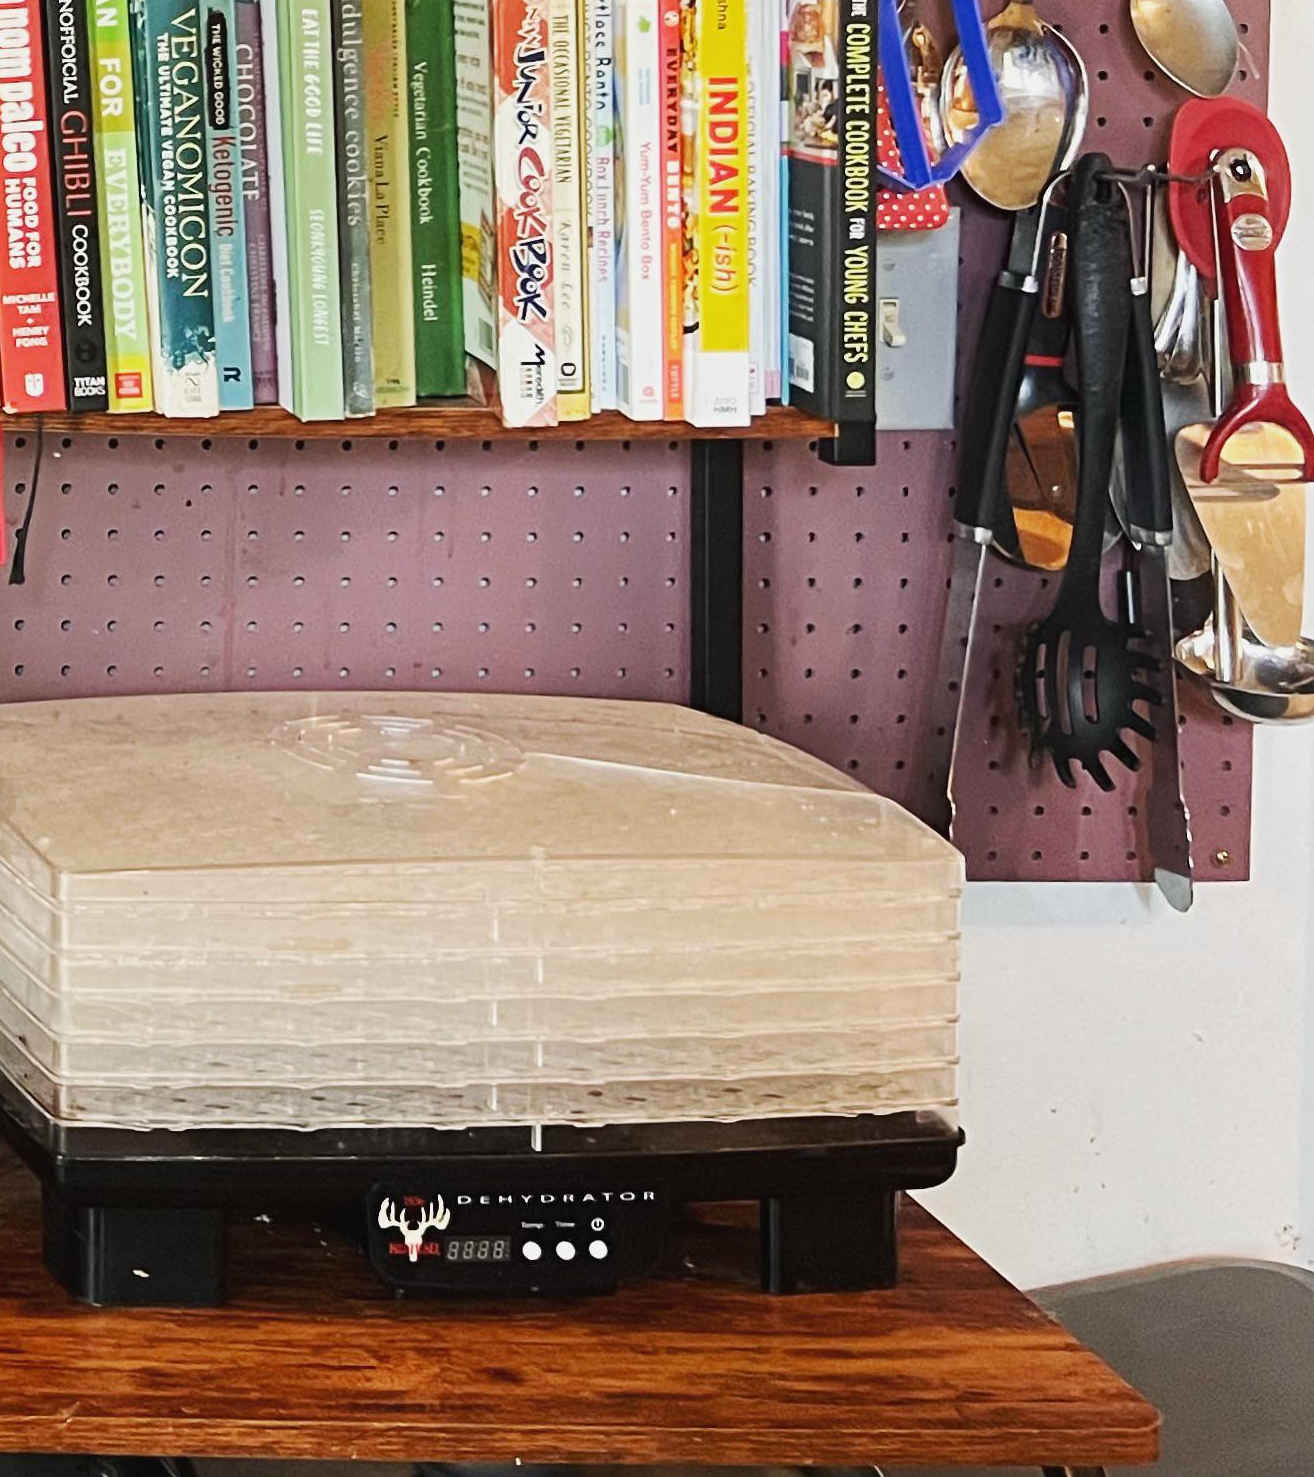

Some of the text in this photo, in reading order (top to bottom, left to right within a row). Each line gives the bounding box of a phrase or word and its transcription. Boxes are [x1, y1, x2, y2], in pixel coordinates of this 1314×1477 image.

[211, 24, 221, 44] THE
[212, 46, 222, 89] WICKED
[844, 23, 871, 114] COMPLETE
[98, 57, 123, 118] FOR
[213, 91, 225, 124] GOOD
[235, 43, 260, 201] CHOCOLATE
[301, 8, 322, 155] EAT THE GOOD LIFE
[553, 15, 572, 184] THE OCCASIONAL VEGETARIAN
[666, 48, 678, 153] EVERYDAY
[61, 110, 92, 216] GHIBLI
[157, 33, 180, 278] THE ULTIMATE VEGAN COOKBOOK
[170, 8, 210, 298] VEGANOMICON
[208, 136, 238, 237] Ketogenic
[344, 130, 366, 226] cookies
[375, 135, 390, 244] Viana La Place
[414, 62, 438, 321] Vegetarian Cookbook Heindel
[666, 160, 681, 229] BENTO
[708, 77, 739, 292] INDIAN (-ish)
[844, 117, 870, 213] COOKBOOK
[4, 178, 28, 269] HUMANS
[21, 177, 42, 268] FOOD FOR
[104, 150, 137, 341] EVERYBODY
[639, 142, 653, 280] Yum-Yum Bento Box
[848, 218, 866, 240] FOR
[17, 305, 42, 314] TAM
[71, 224, 93, 326] COOKBOOK
[313, 294, 331, 345] LONGEST
[843, 245, 870, 304] YOUNG
[12, 326, 50, 337] HENRY
[15, 336, 49, 348] FONG
[843, 311, 869, 364] CHEFS
[73, 376, 105, 387] TITAN
[74, 385, 105, 397] BOOKS
[457, 1191, 655, 1205] DEHYDRATOR
